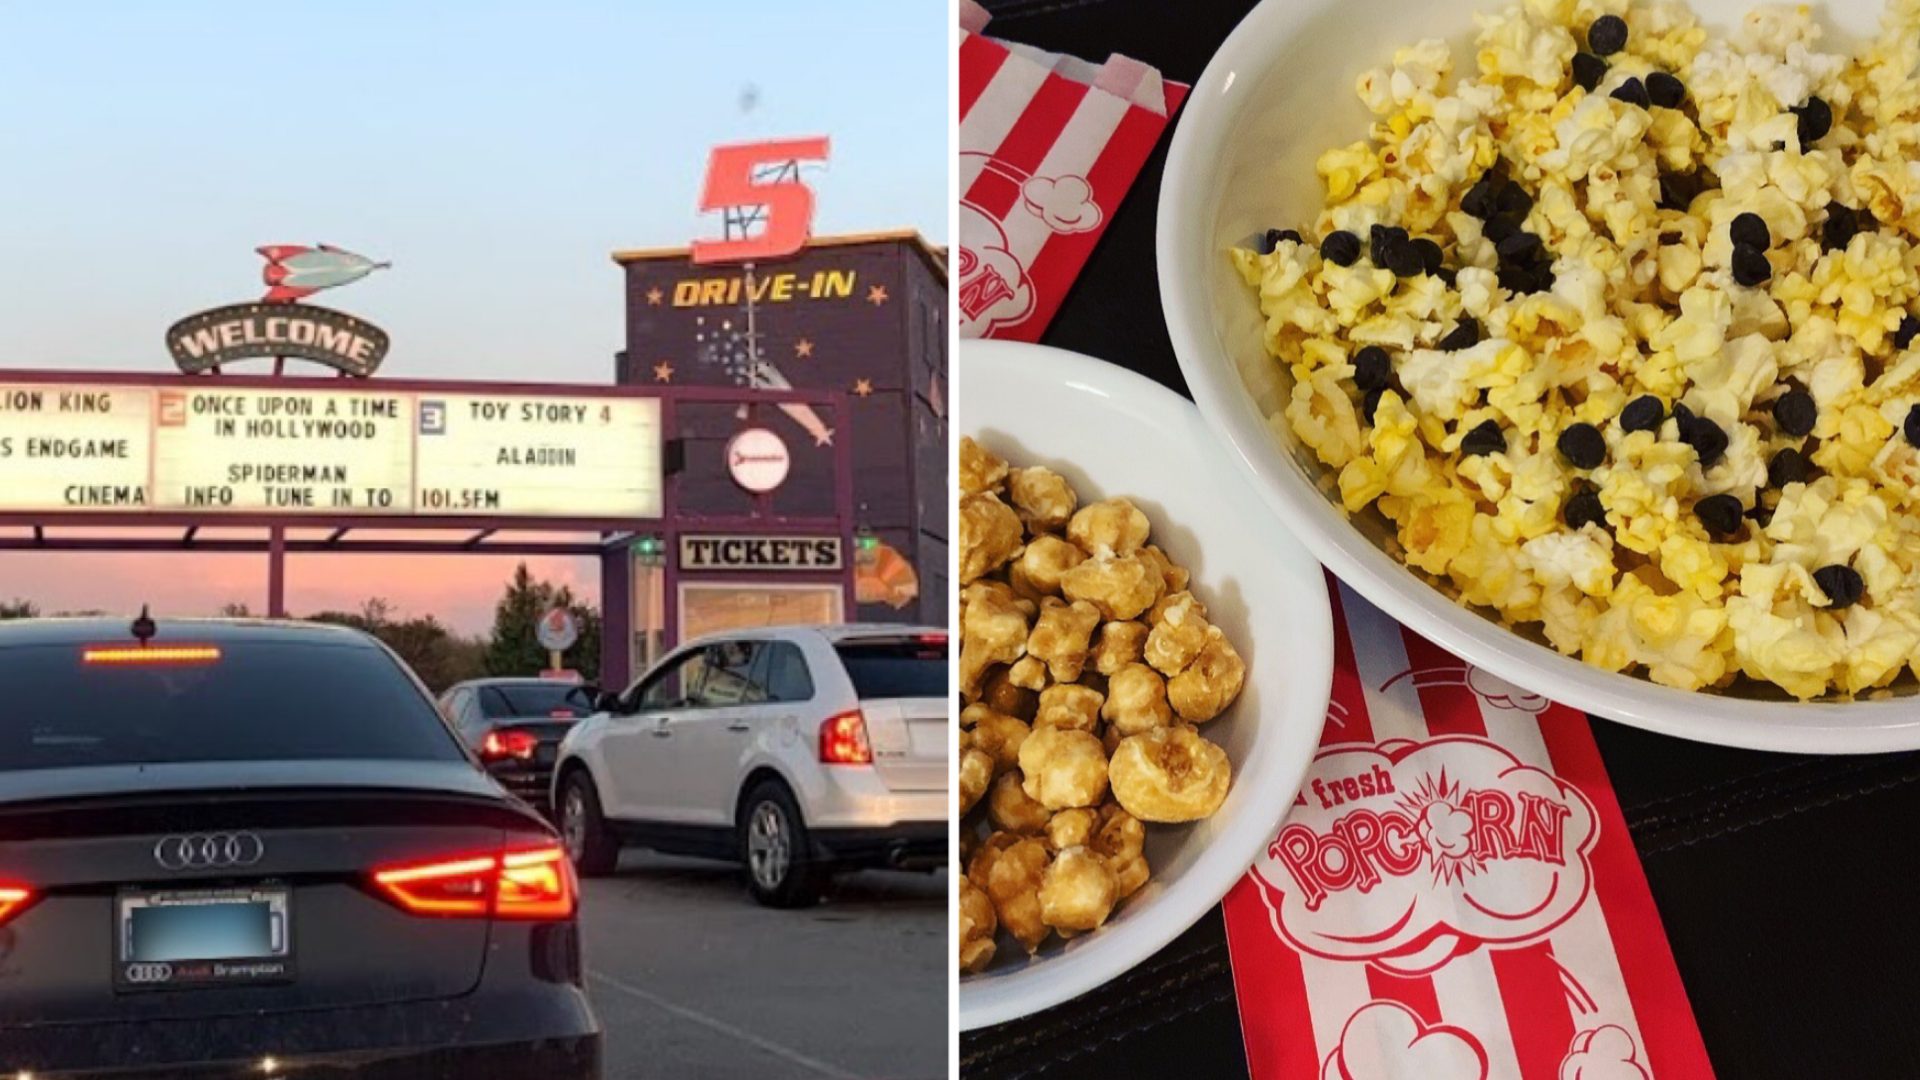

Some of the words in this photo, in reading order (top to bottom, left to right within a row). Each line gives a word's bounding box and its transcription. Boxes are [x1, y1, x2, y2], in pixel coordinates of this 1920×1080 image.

[691, 137, 832, 263] 5
[672, 270, 856, 307] DRIVE-IN
[180, 317, 375, 362] WELCOME
[0, 391, 42, 411] ION
[59, 391, 111, 412] KING
[193, 395, 246, 415] ONCE
[257, 396, 312, 416] UPON
[325, 398, 337, 415] A
[350, 399, 398, 417] TIME
[469, 401, 509, 420] TOY
[521, 402, 587, 423] STORY
[599, 405, 612, 423] 4
[215, 419, 235, 436] IN
[246, 419, 376, 438] HOLLYWOOD
[27, 438, 128, 458] ENDGAME
[496, 447, 576, 466] ALADDIN
[228, 463, 347, 483] SPIDERMAN
[64, 485, 145, 505] CINEMA
[185, 487, 233, 506] INFO
[264, 487, 314, 507] TUNE
[332, 488, 353, 507] IN
[365, 488, 393, 507] TO
[686, 539, 836, 565] TICKETS
[1312, 765, 1395, 809] fresh
